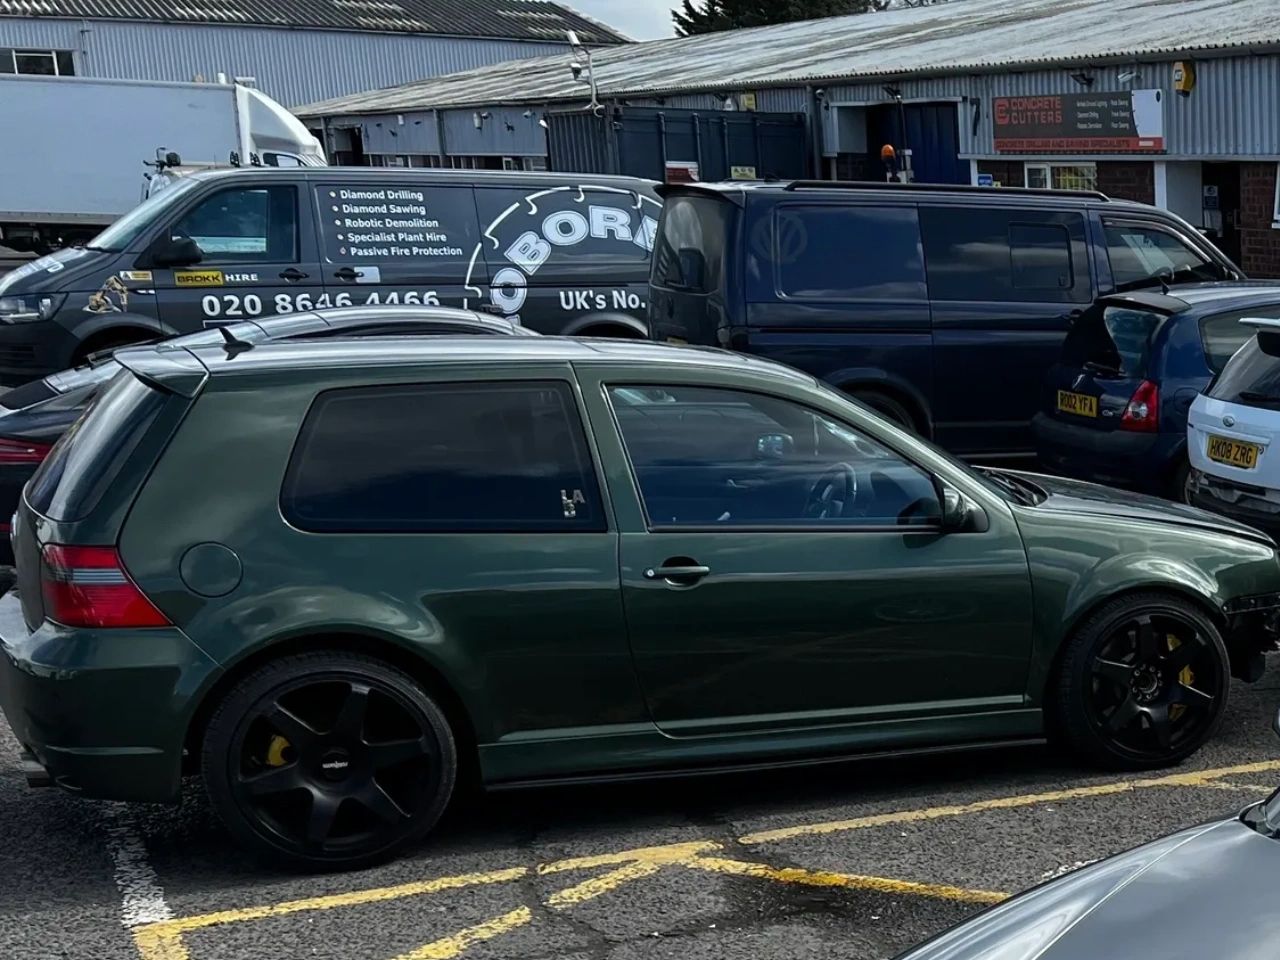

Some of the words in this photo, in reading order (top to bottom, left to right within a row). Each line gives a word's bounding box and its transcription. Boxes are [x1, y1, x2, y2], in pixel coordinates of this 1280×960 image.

[1011, 97, 1062, 110] CONCRETE
[970, 97, 980, 137] 7
[1011, 111, 1062, 124] CUTTERS
[340, 190, 385, 200] Diamond
[387, 190, 424, 201] Drilling
[342, 204, 387, 214] Diamond
[390, 204, 426, 215] Sawing
[344, 219, 383, 228] Robotic
[386, 218, 439, 228] Demolition
[347, 232, 396, 244] Specialist
[398, 232, 424, 242] Plant
[426, 232, 447, 242] Hire
[351, 247, 388, 256] Passive
[390, 247, 410, 256] Fire
[412, 247, 463, 256] Protection
[225, 273, 259, 281] HIRE
[202, 294, 262, 316] 020
[275, 293, 353, 314] 8646
[560, 290, 607, 310] UK's
[612, 290, 647, 310] No.
[1233, 444, 1253, 465] ZRG
